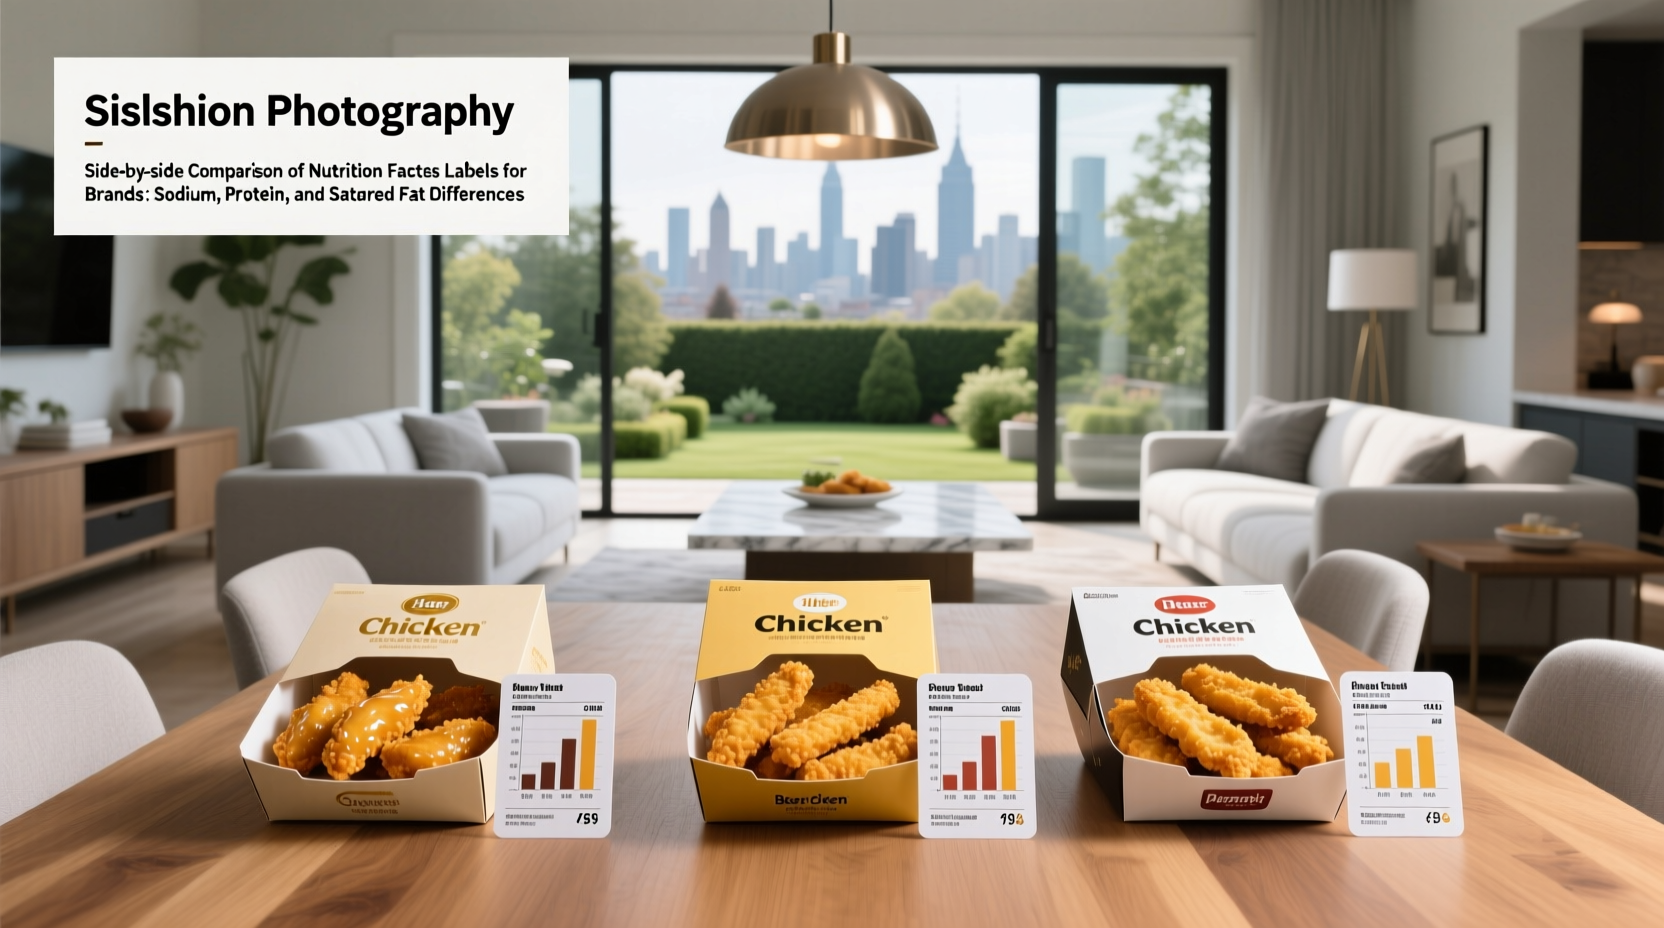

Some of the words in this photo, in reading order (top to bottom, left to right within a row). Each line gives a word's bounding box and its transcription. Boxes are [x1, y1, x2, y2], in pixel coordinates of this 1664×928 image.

[358, 616, 481, 637] Chicken
[754, 614, 883, 633] Chicken
[1132, 617, 1256, 636] Chicken
